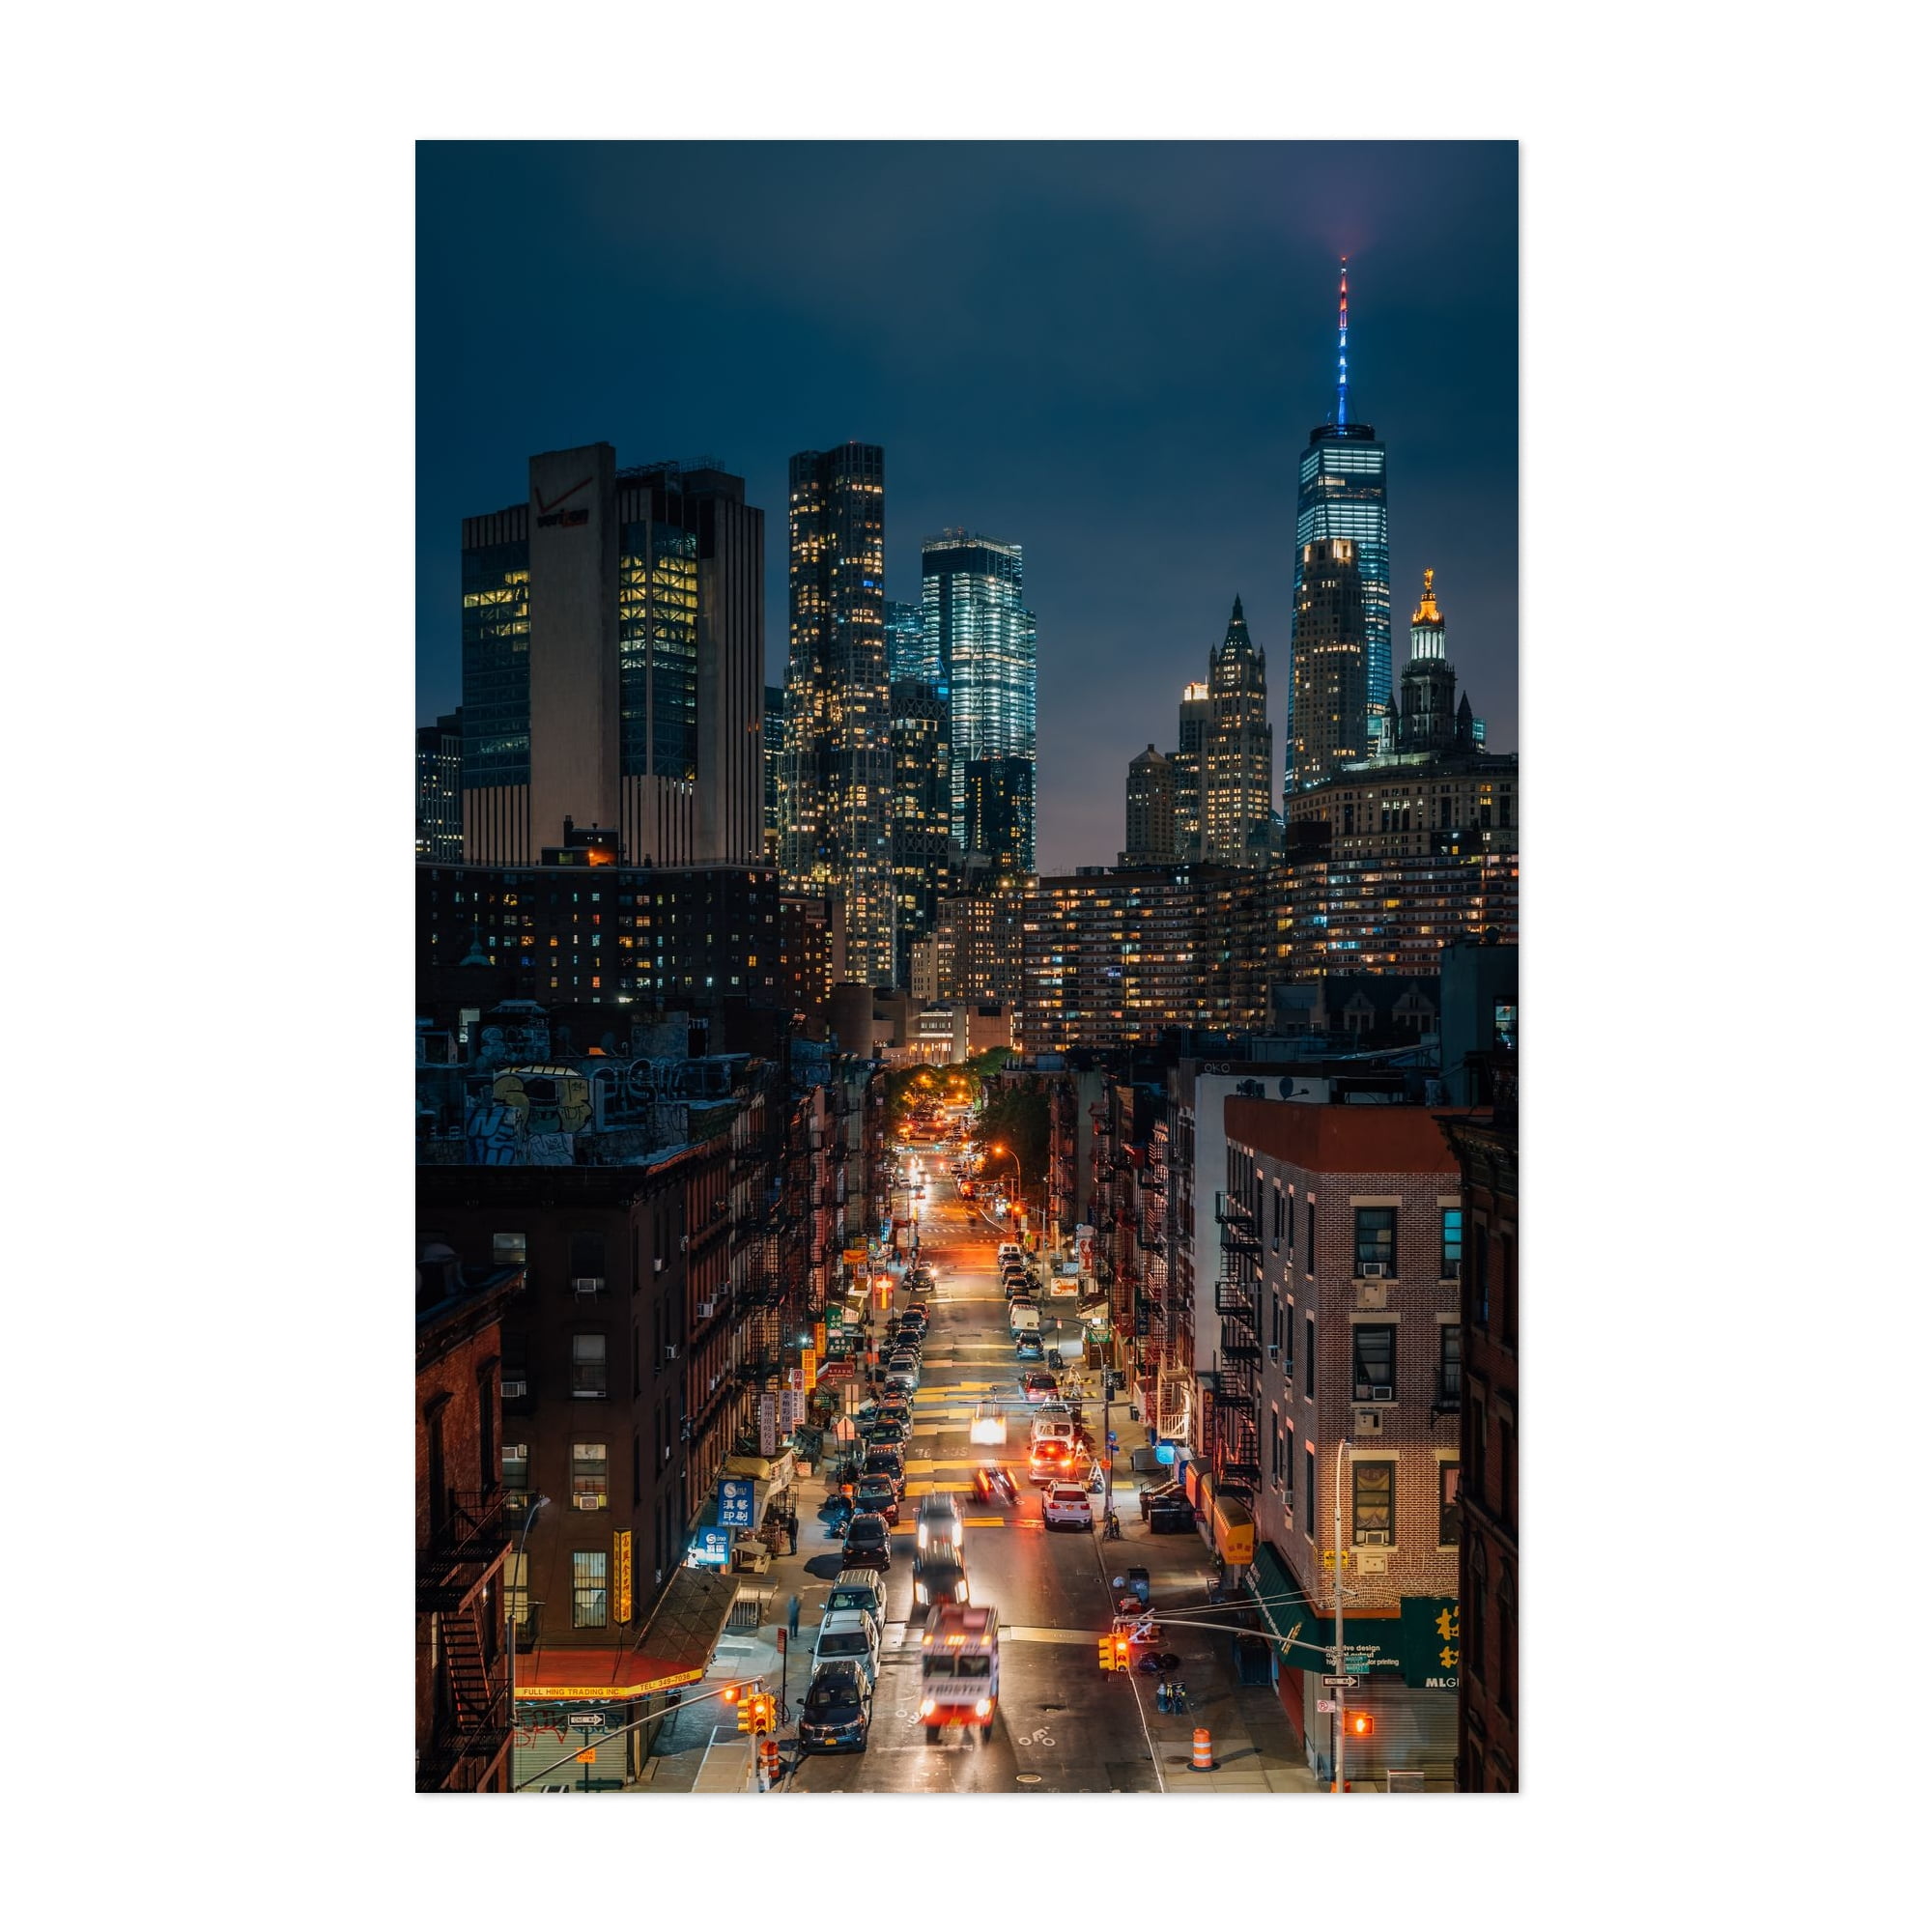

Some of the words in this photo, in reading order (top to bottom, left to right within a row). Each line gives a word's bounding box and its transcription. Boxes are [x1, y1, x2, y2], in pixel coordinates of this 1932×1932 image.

[1355, 1644, 1381, 1654] design
[1377, 1658, 1400, 1667] printing
[1425, 1677, 1459, 1688] MLG
